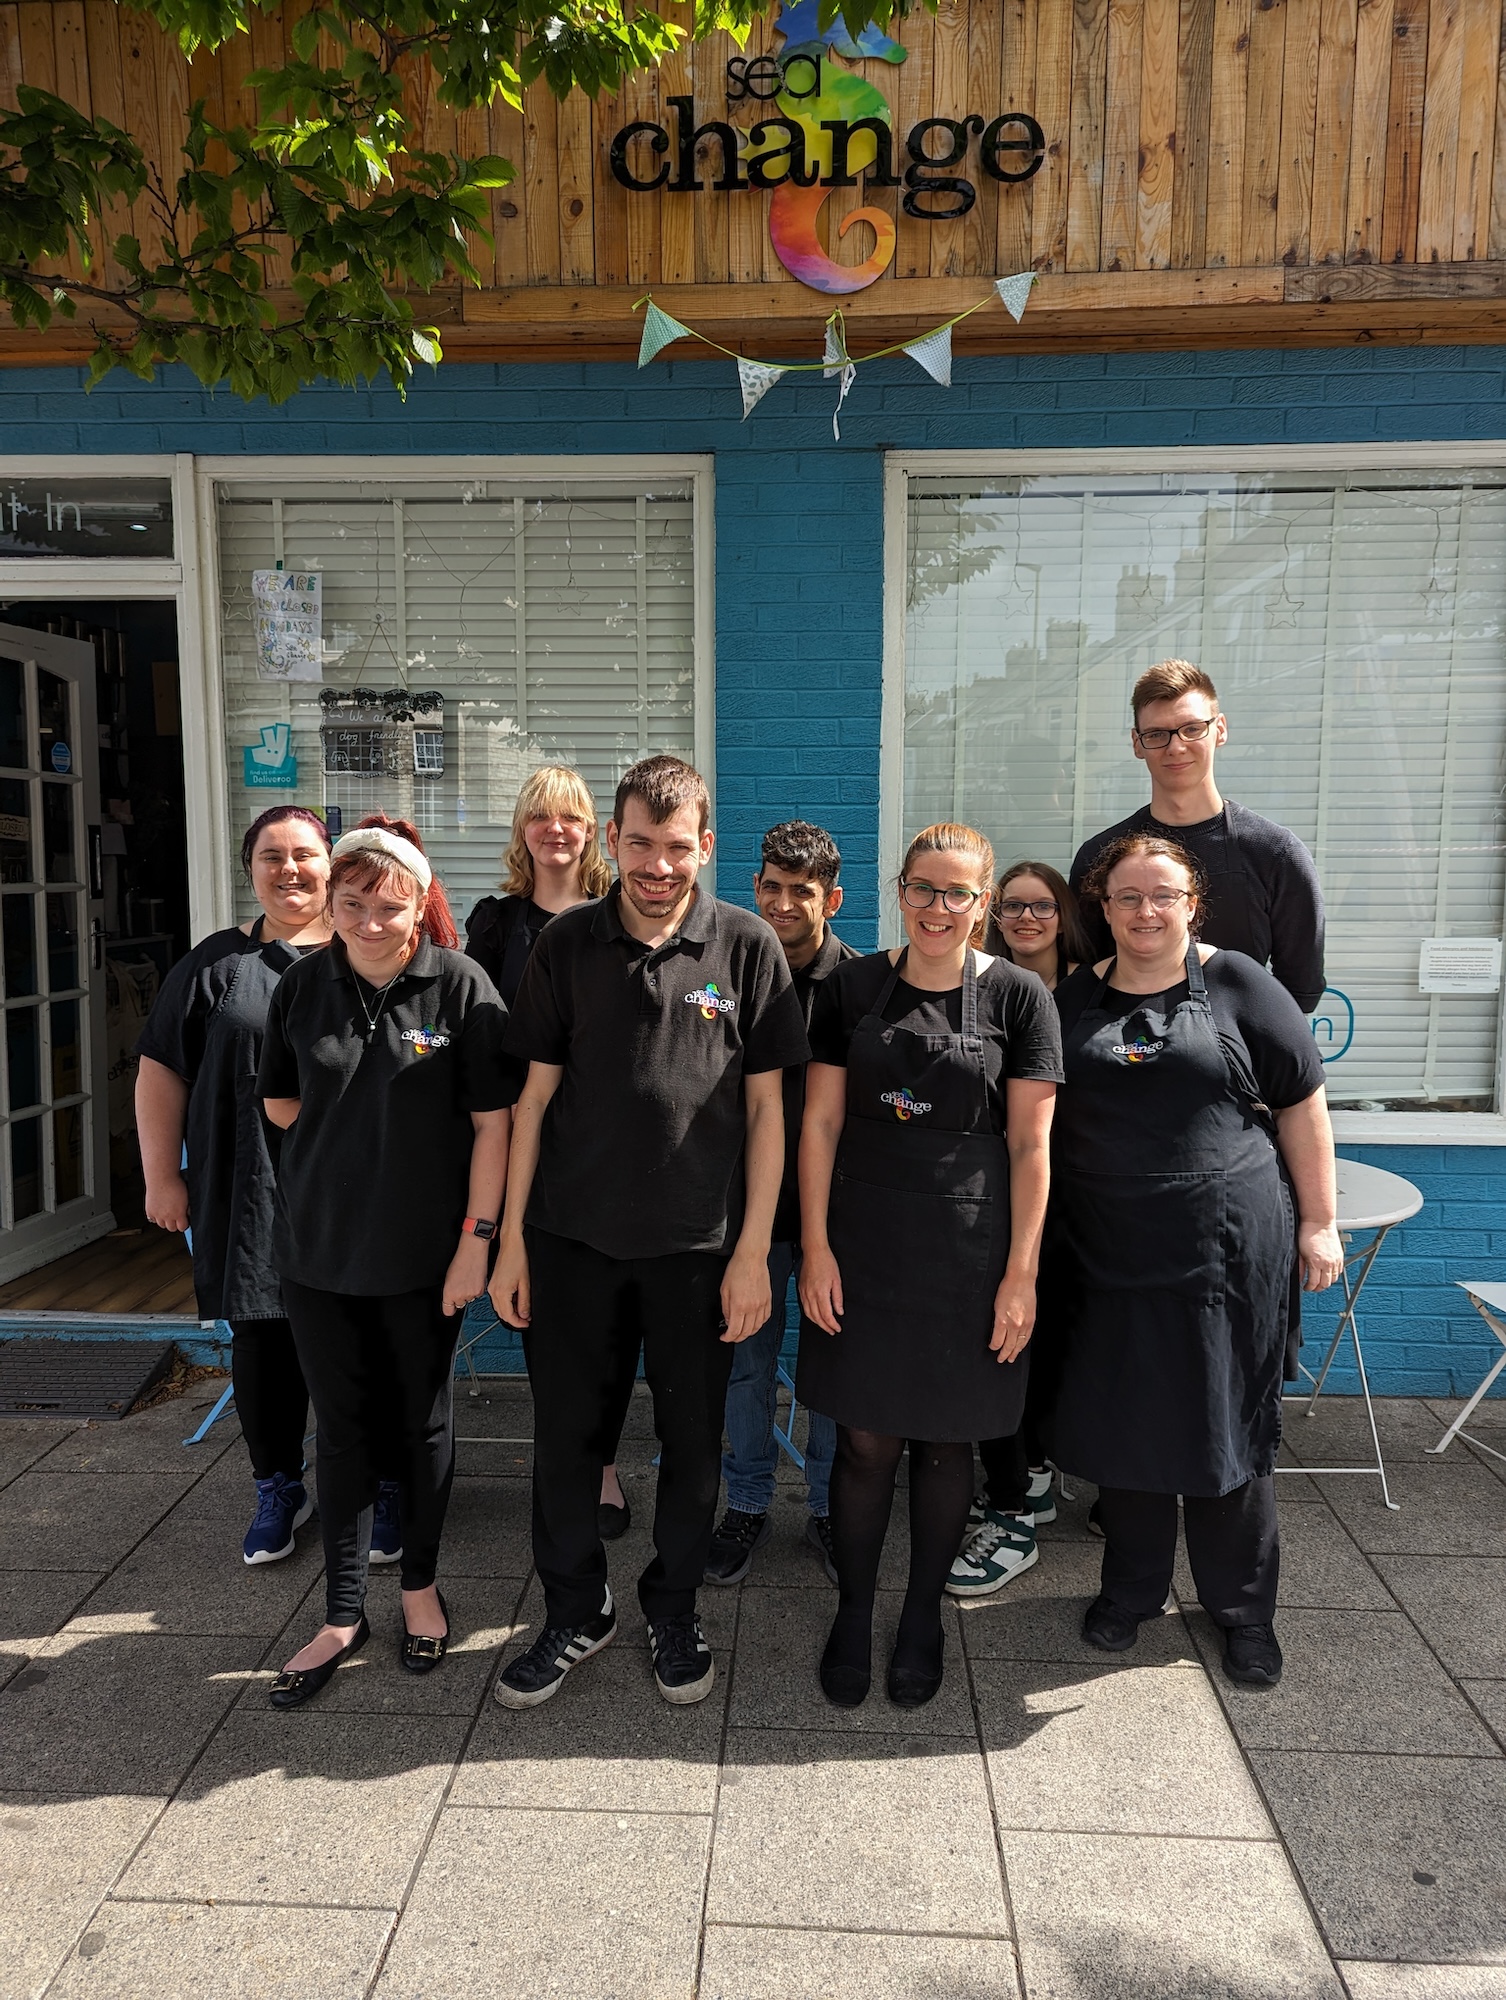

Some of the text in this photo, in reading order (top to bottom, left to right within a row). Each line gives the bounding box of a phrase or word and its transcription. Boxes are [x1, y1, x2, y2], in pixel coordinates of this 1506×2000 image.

[725, 53, 821, 100] sea
[610, 95, 1045, 219] change
[46, 492, 82, 531] In
[255, 575, 317, 592] WE ARE
[280, 598, 319, 615] CLOSED
[350, 710, 393, 723] We are
[339, 729, 359, 747] dog
[252, 774, 292, 783] Deliveroo
[684, 990, 736, 1013] change
[401, 1029, 450, 1048] change
[1112, 1040, 1164, 1055] change
[880, 1091, 933, 1115] change
